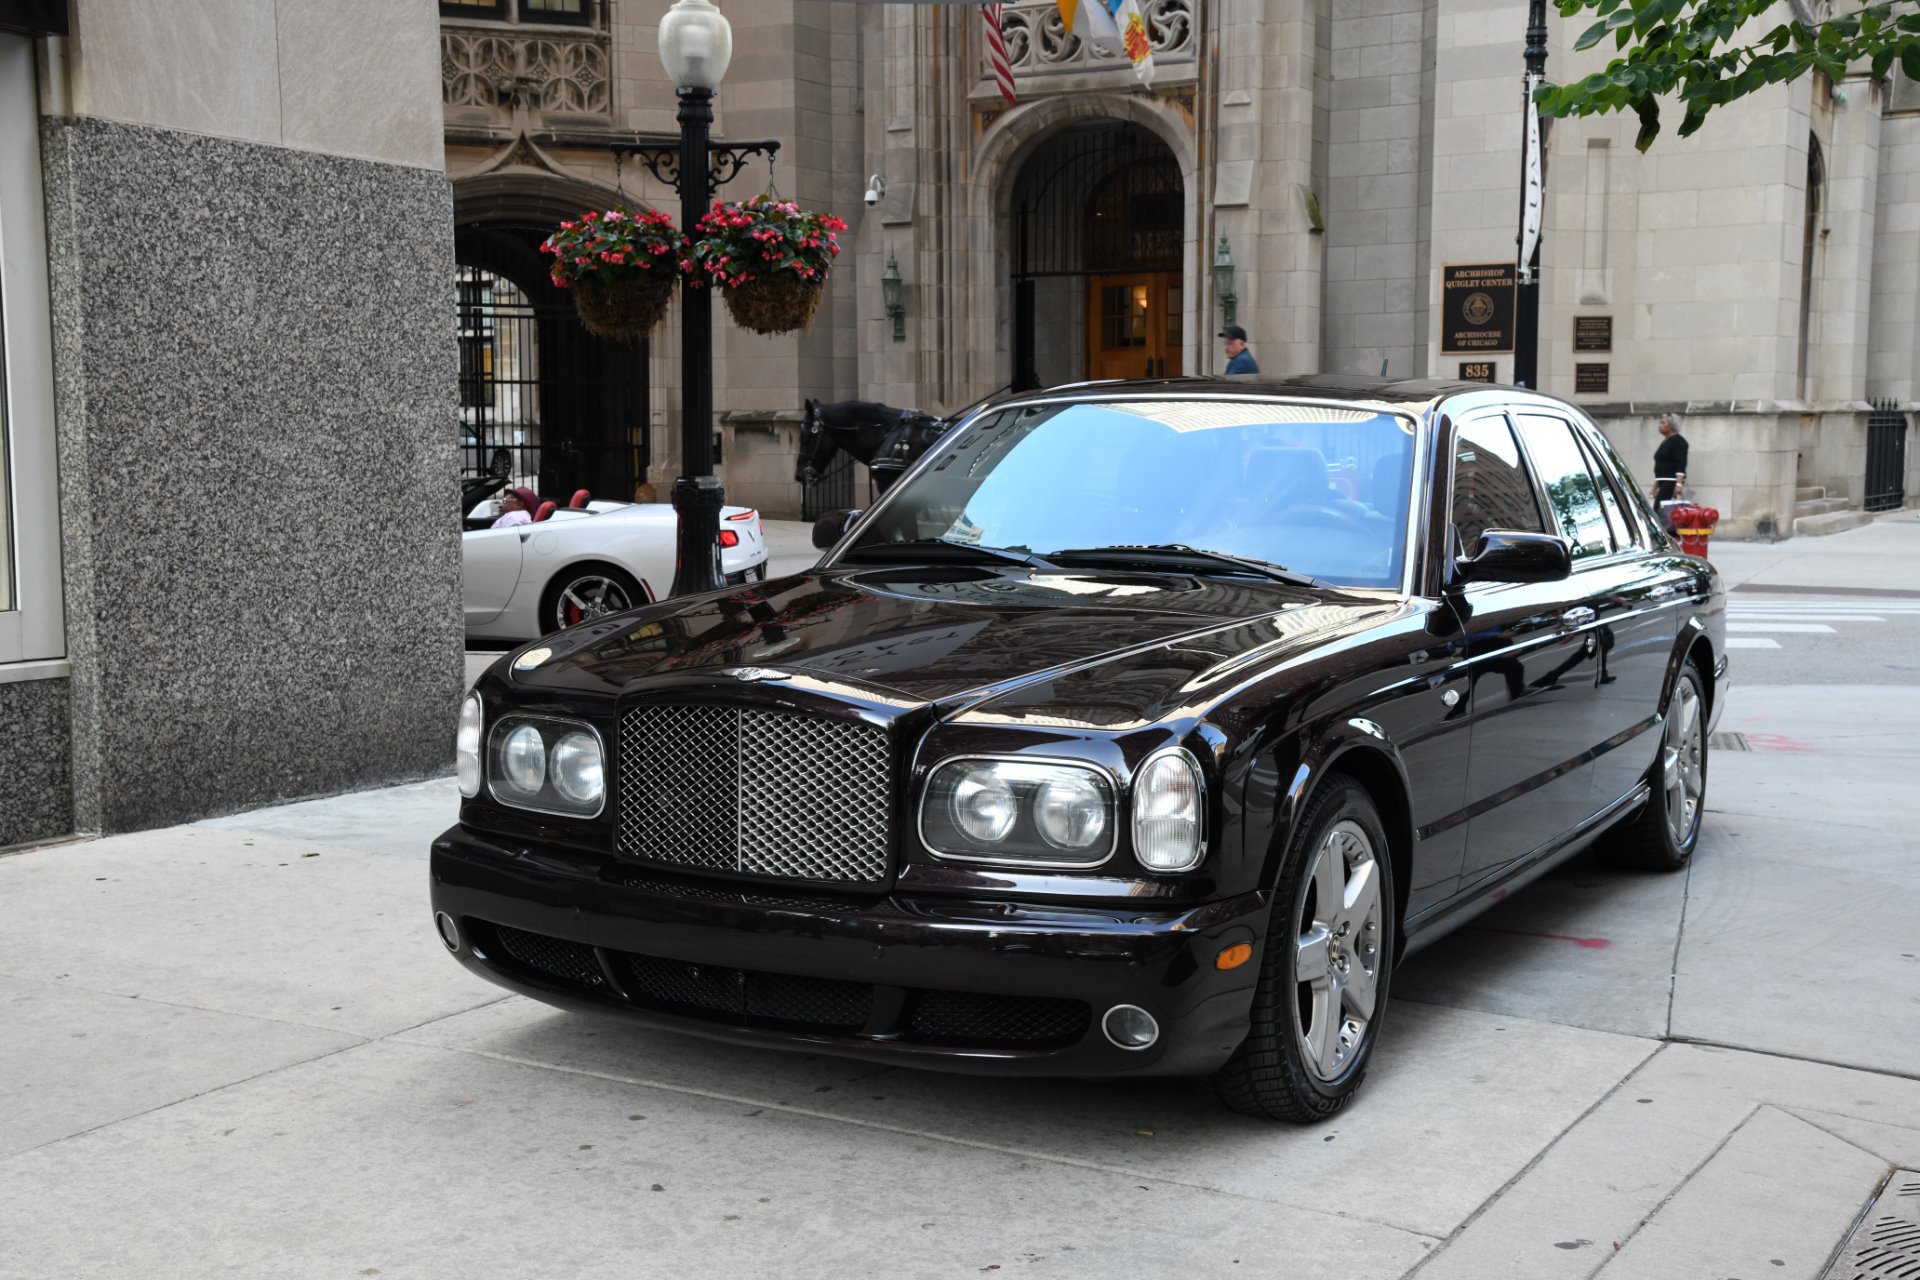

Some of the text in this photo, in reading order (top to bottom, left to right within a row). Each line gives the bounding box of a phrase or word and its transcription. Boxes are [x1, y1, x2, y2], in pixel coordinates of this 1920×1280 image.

[1454, 270, 1505, 278] ARCHBISHOP
[1445, 278, 1513, 289] QUIGLEY CENTER
[1454, 330, 1502, 339] ARCHDIOCESE
[1465, 364, 1489, 378] 835
